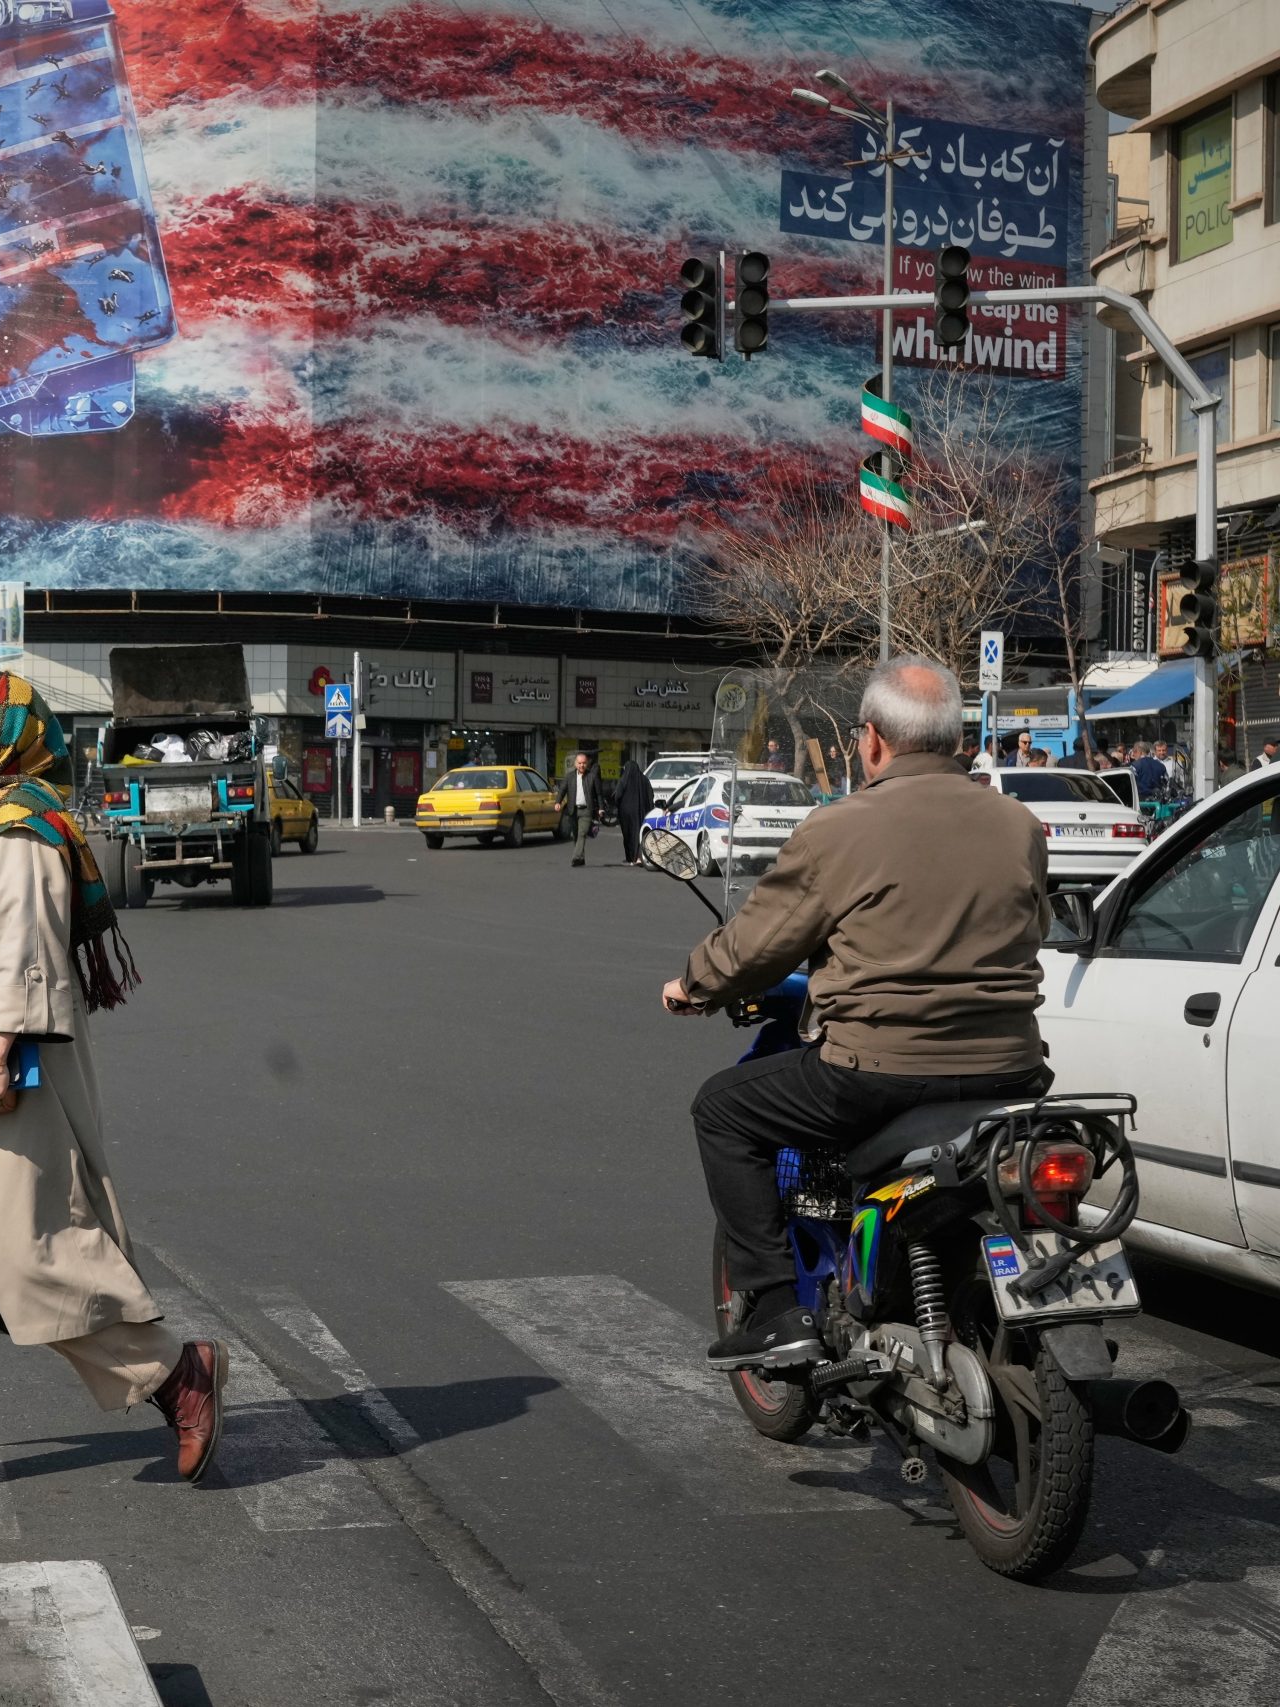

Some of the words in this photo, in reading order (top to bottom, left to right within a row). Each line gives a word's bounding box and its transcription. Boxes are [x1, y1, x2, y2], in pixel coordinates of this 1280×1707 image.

[861, 126, 935, 184] بکرد
[939, 132, 988, 191] باد
[949, 197, 1058, 258] طوفان
[1185, 200, 1233, 241] POLIC
[898, 255, 911, 275] If
[915, 262, 935, 281] yo
[988, 266, 1014, 287] the
[1019, 271, 1056, 290] wind
[1024, 303, 1059, 324] the
[892, 316, 1058, 372] whlwind
[1133, 571, 1146, 651] SAMSUNG
[393, 669, 437, 696] بانک
[510, 688, 551, 704] ساعتی
[636, 679, 658, 696] ملی
[658, 679, 690, 697] کفش
[993, 1259, 1008, 1268] I.R.
[995, 1266, 1018, 1275] IRAN
